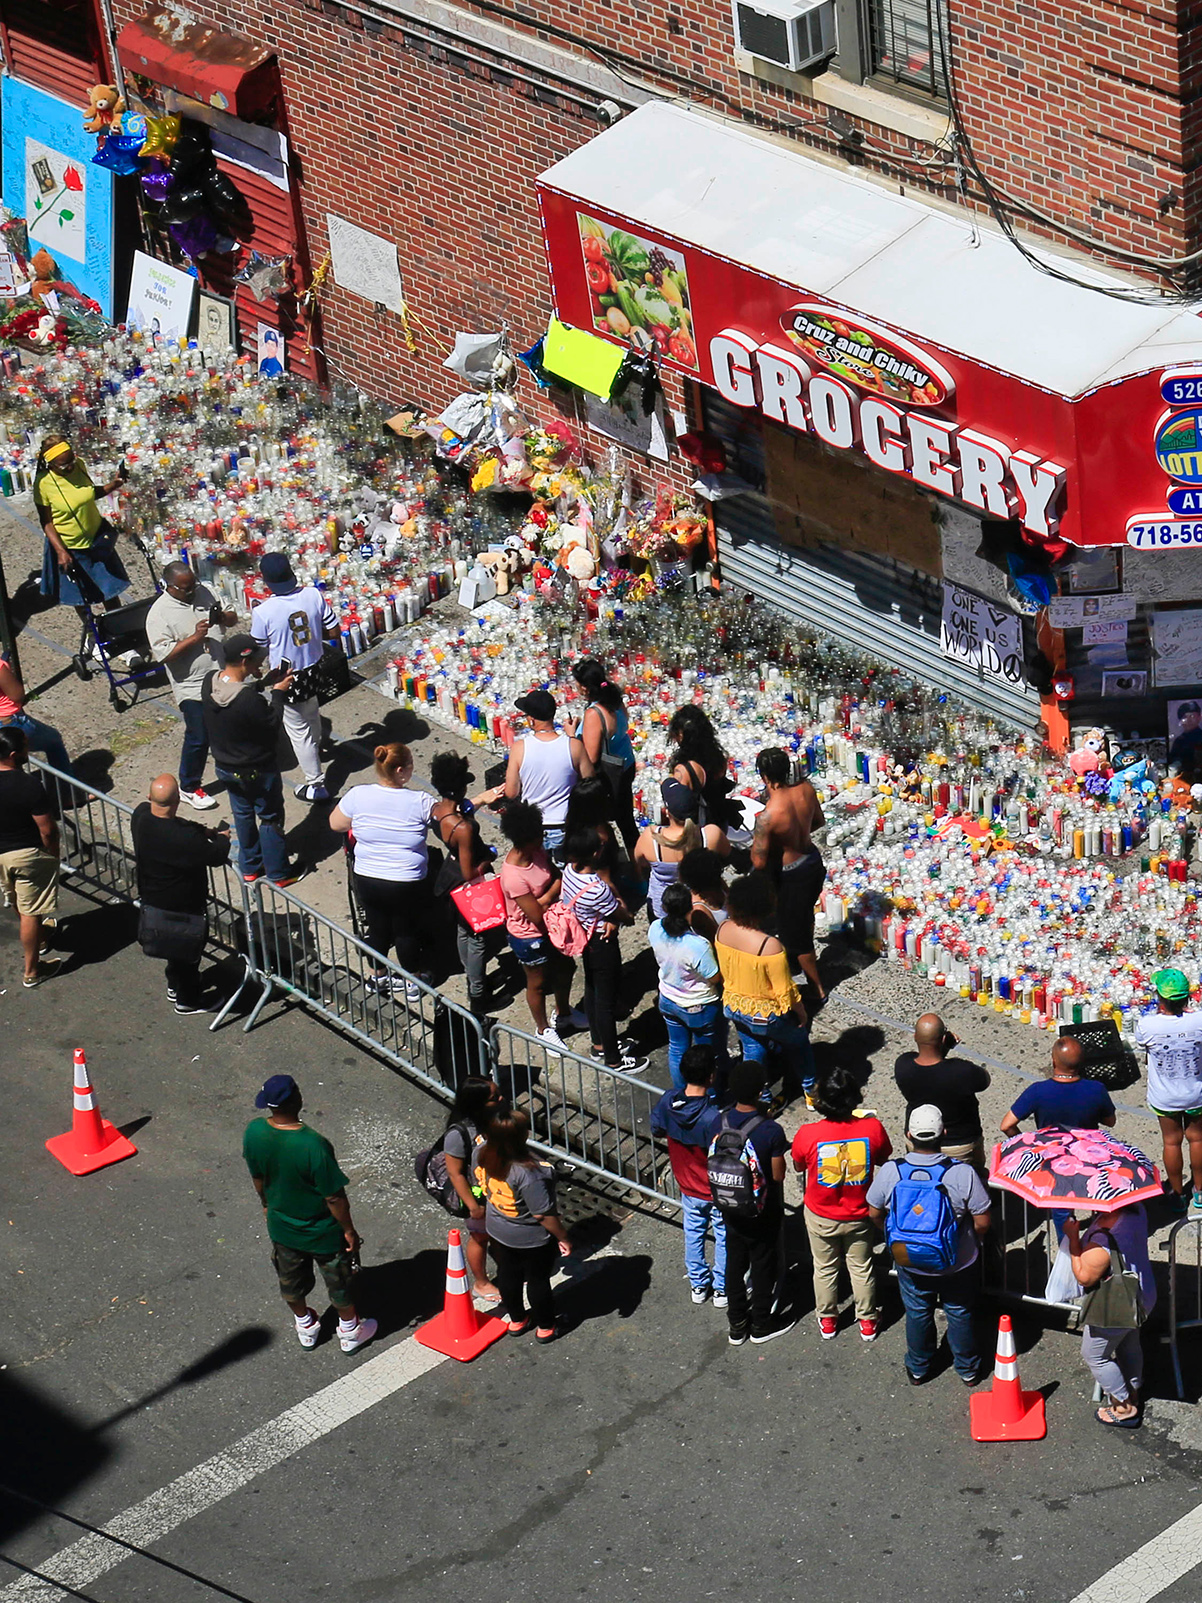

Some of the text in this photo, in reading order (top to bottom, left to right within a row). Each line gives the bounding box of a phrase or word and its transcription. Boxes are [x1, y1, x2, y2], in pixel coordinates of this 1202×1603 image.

[793, 315, 930, 387] Cruz and Chiky
[816, 346, 876, 379] Store
[709, 328, 1067, 538] GROCERY
[951, 591, 980, 617] ONE
[288, 610, 312, 648] 8
[951, 610, 979, 637] ONE
[985, 627, 1009, 648] US
[943, 623, 1002, 674] WORLD
